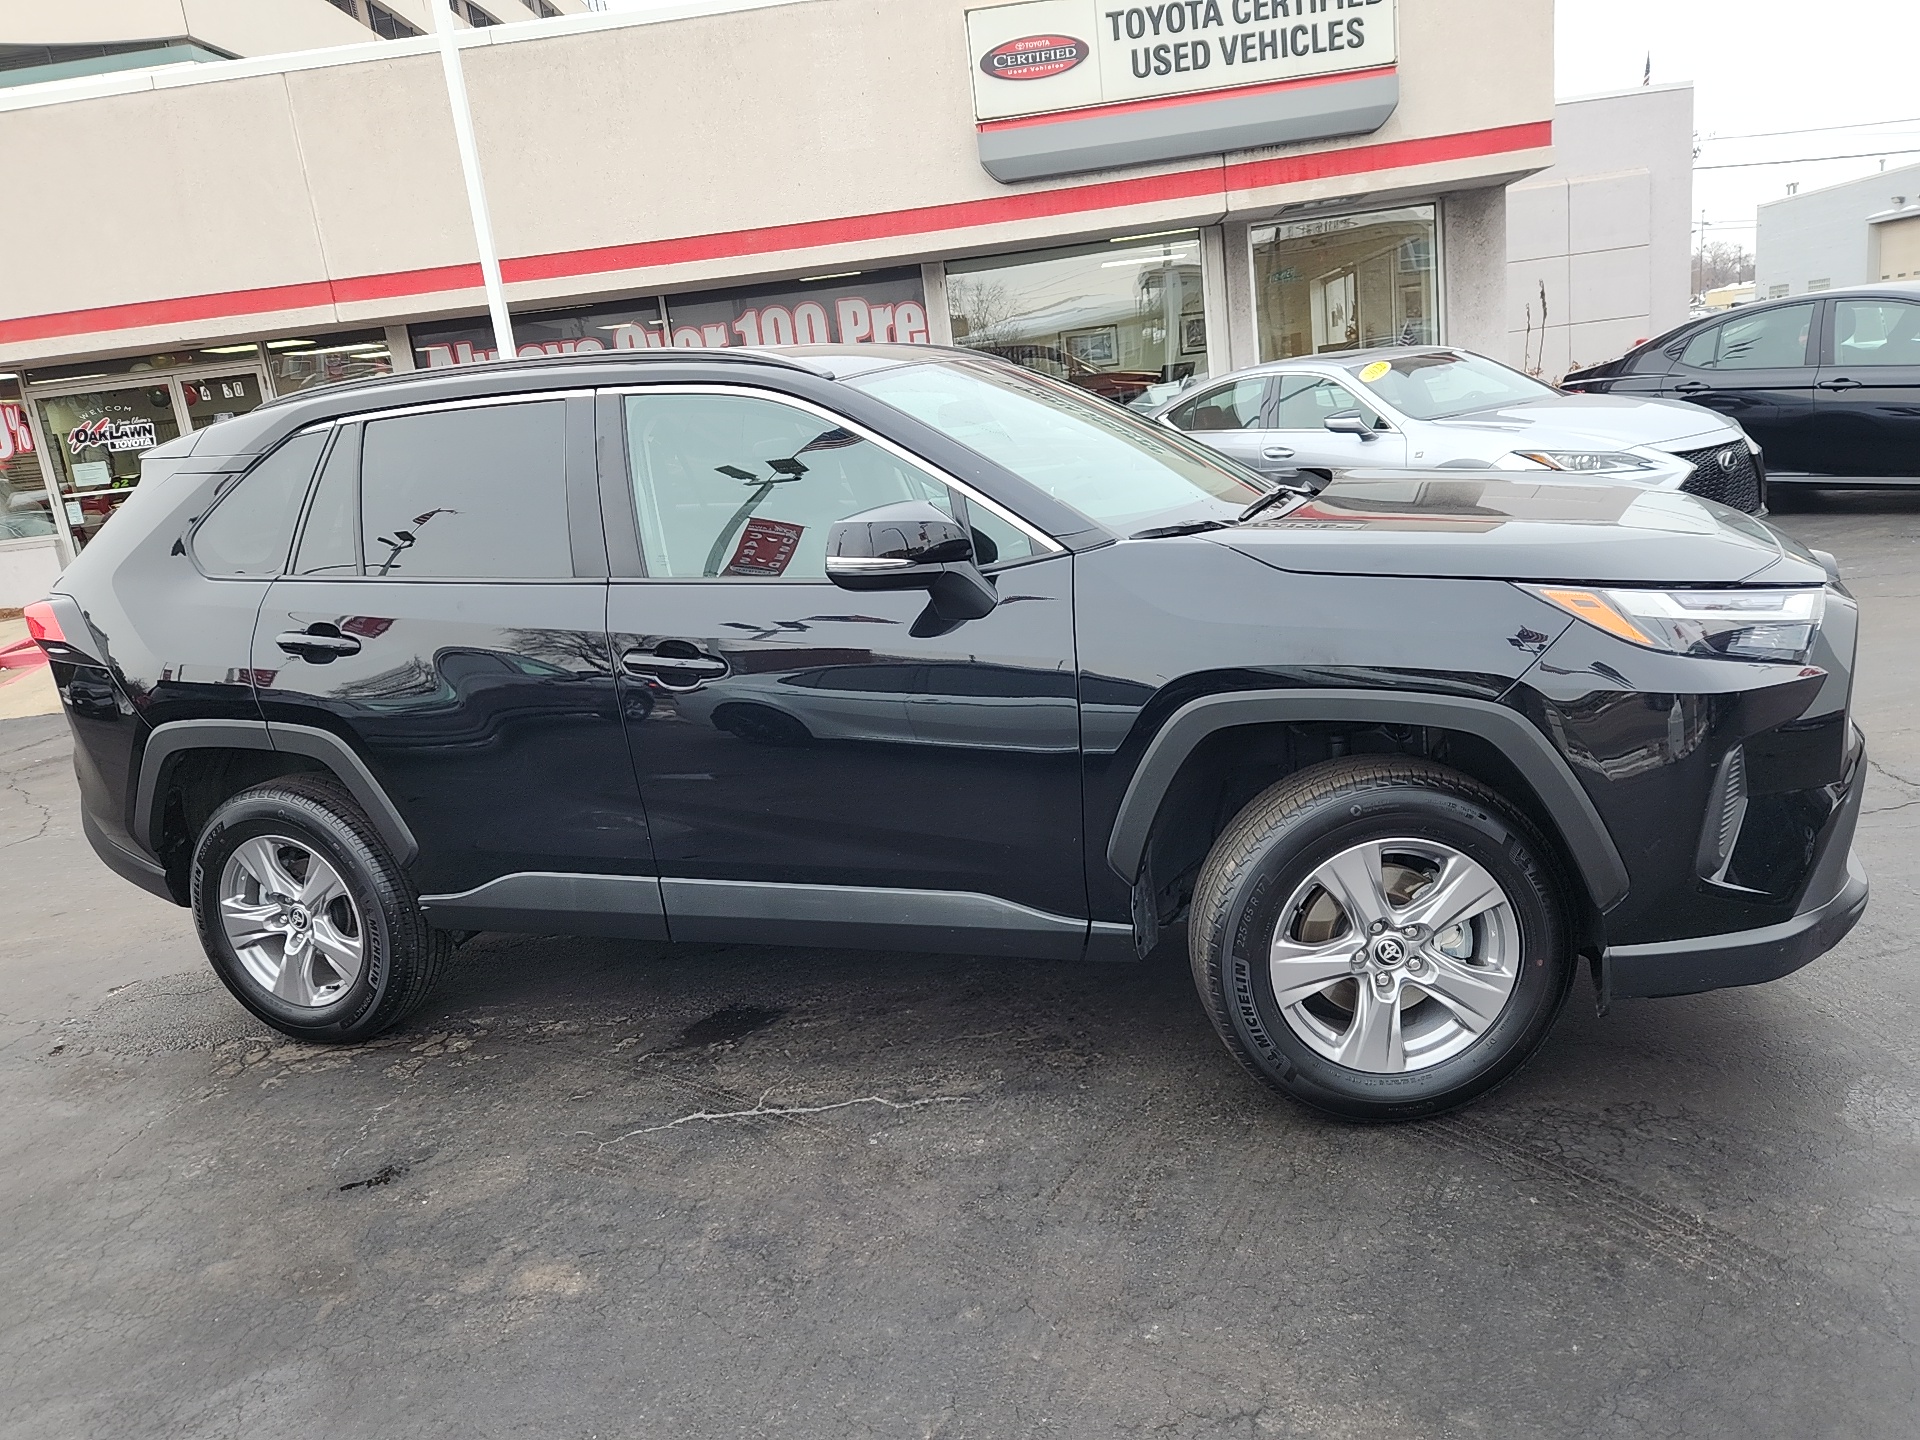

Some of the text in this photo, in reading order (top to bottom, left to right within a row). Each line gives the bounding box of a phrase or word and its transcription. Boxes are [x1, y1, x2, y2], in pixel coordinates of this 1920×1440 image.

[1105, 0, 1224, 41] TOYOTA
[993, 47, 1077, 68] CERTIFIED
[1025, 40, 1050, 48] TOYOTA
[1131, 17, 1365, 78] USED VEHICLES
[1030, 63, 1064, 72] Vehicles
[732, 301, 830, 345] 100
[836, 297, 930, 344] Pre
[79, 405, 132, 420] WELCOM
[113, 438, 153, 449] TOYOTA
[192, 866, 205, 931] MICHELIN
[1236, 882, 1265, 948] 225/65 R 17
[369, 918, 381, 986] MICHELIN
[1235, 962, 1271, 1049] MICHELIN
